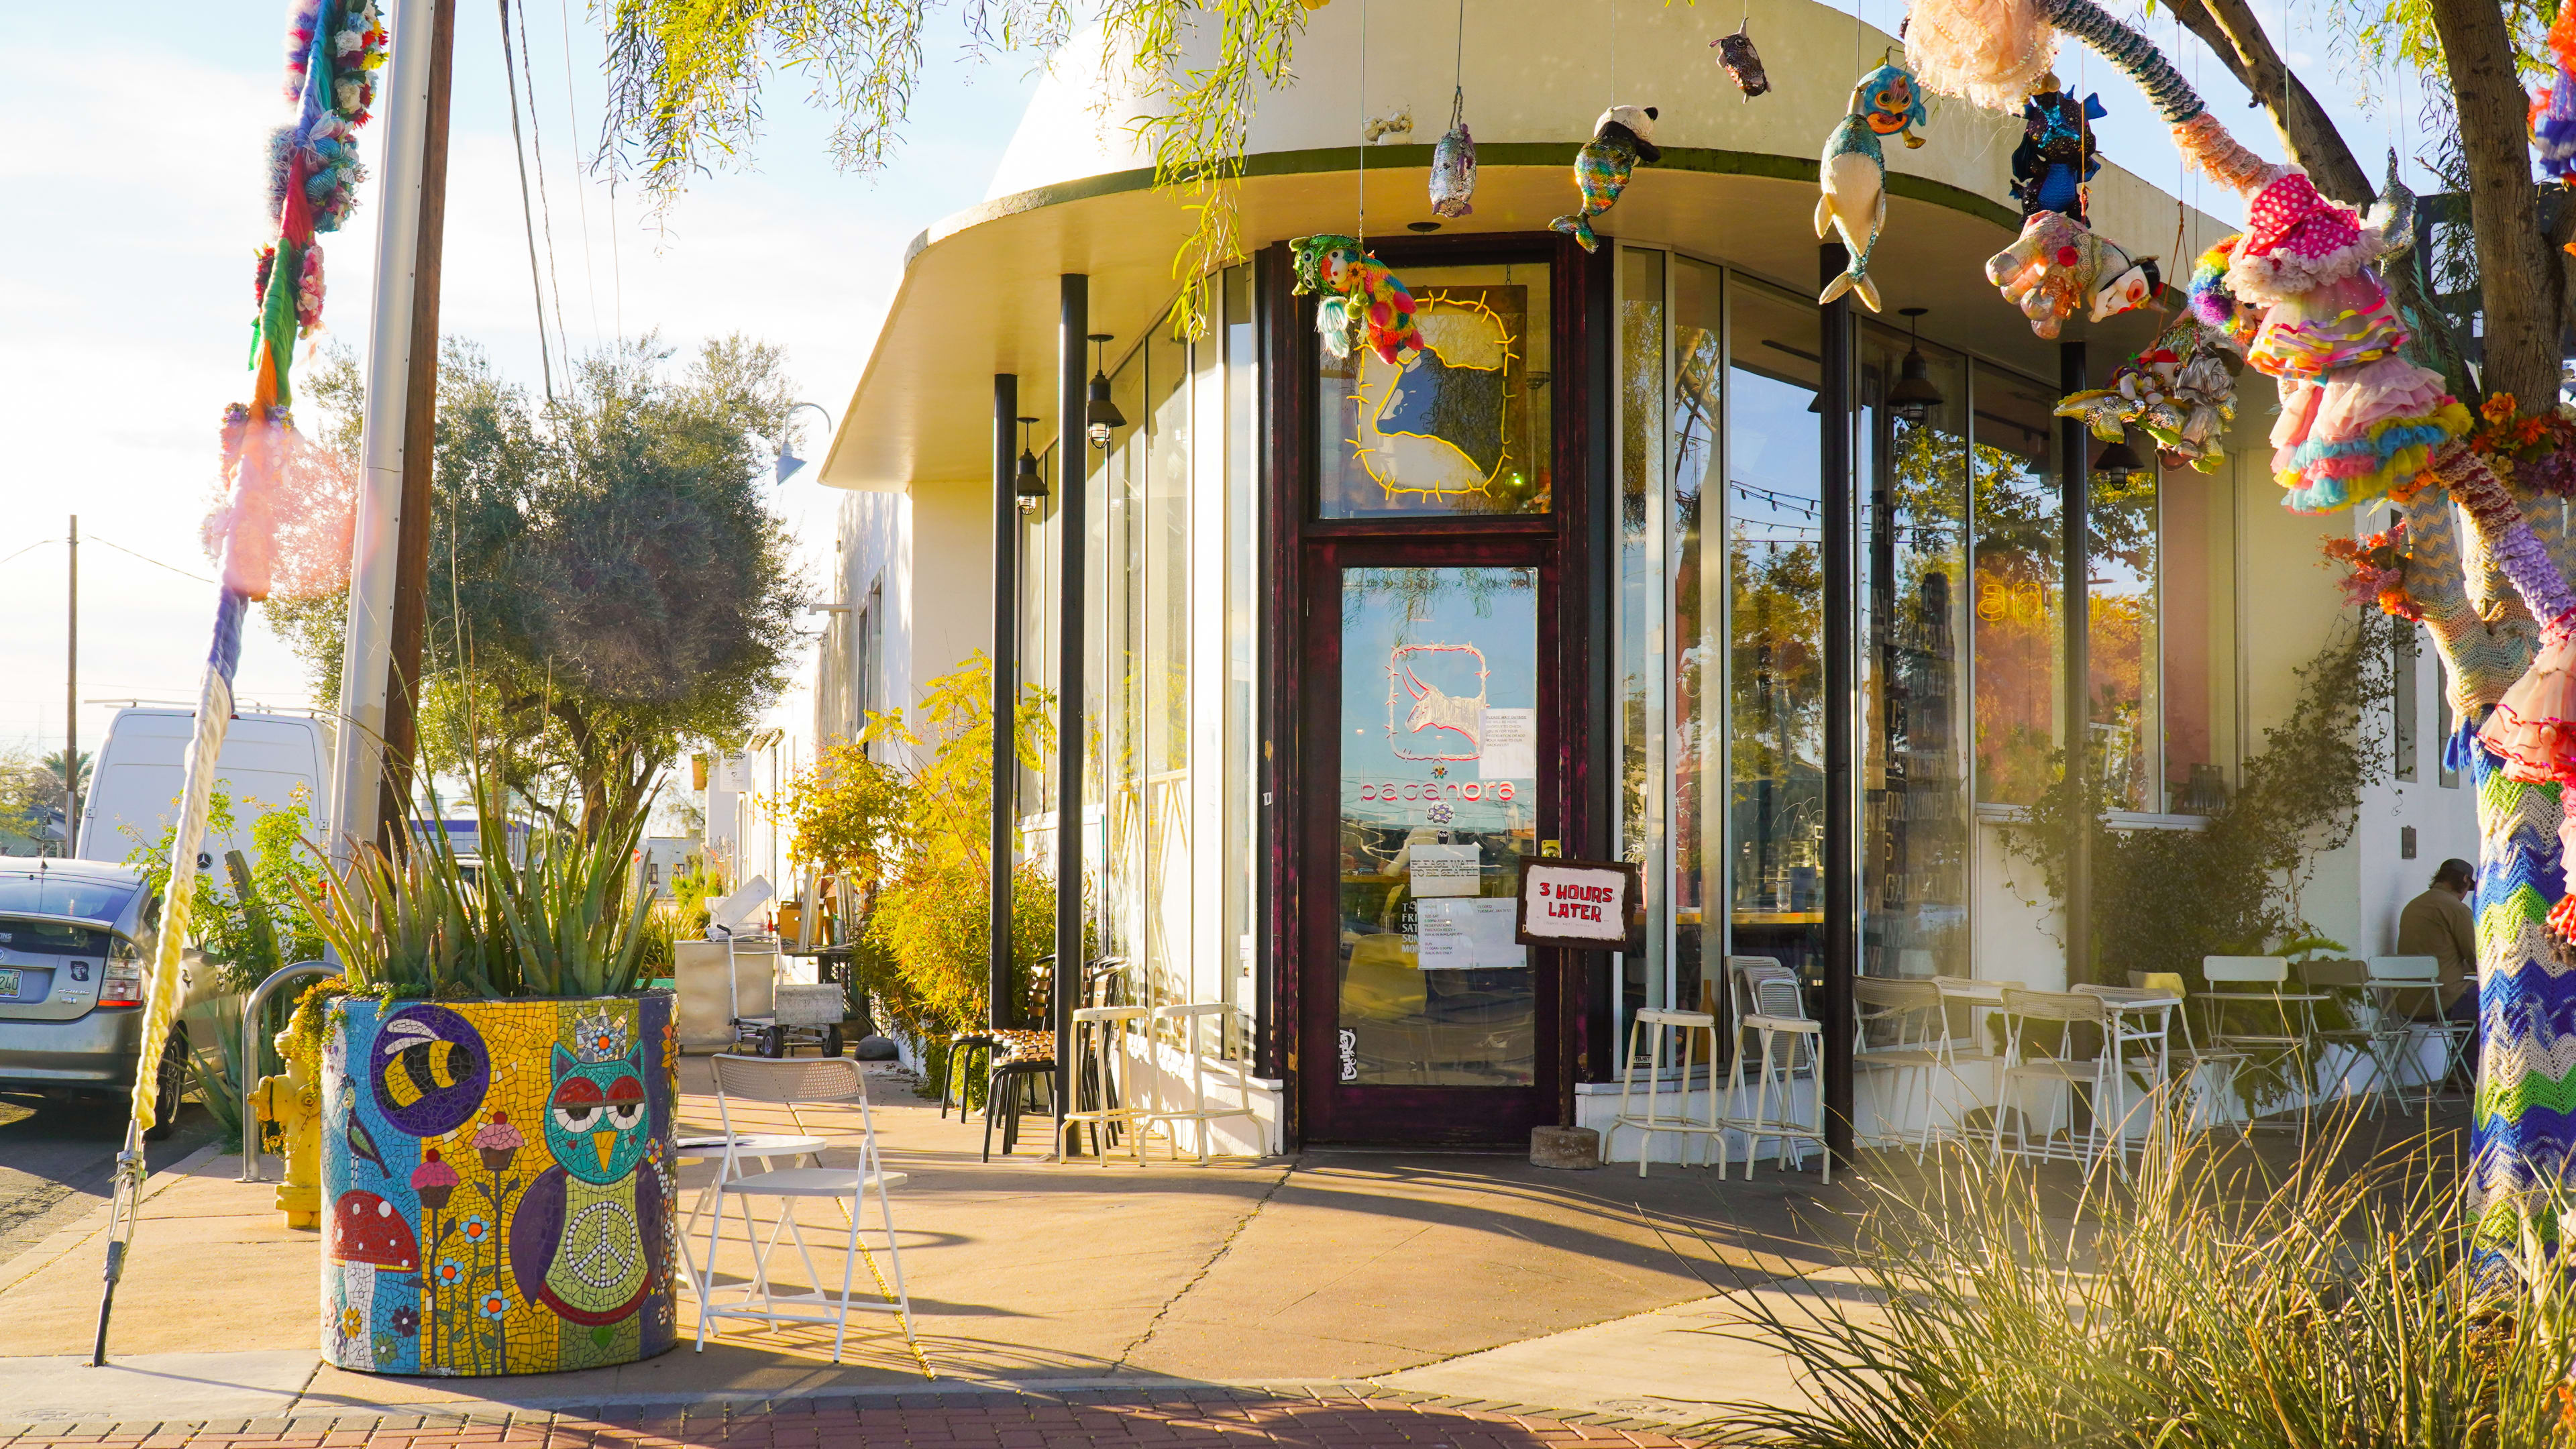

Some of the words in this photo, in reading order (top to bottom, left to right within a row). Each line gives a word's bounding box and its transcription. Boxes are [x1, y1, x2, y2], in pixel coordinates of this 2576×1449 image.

[1360, 765, 1515, 801] bacanora
[1411, 860, 1448, 868] PLEASE
[1450, 860, 1476, 868] WAIT
[1411, 869, 1424, 877] TO
[1426, 869, 1439, 877] BE
[1440, 869, 1479, 877] SEATED
[1540, 882, 1550, 896] 3
[1556, 884, 1613, 903] HOURS
[1548, 902, 1601, 922] LATER
[1401, 913, 1417, 922] FRI
[1401, 924, 1418, 932] SAT
[1401, 934, 1419, 943] SUN
[1401, 944, 1420, 953] MON
[1339, 1029, 1357, 1081] Foulplay
